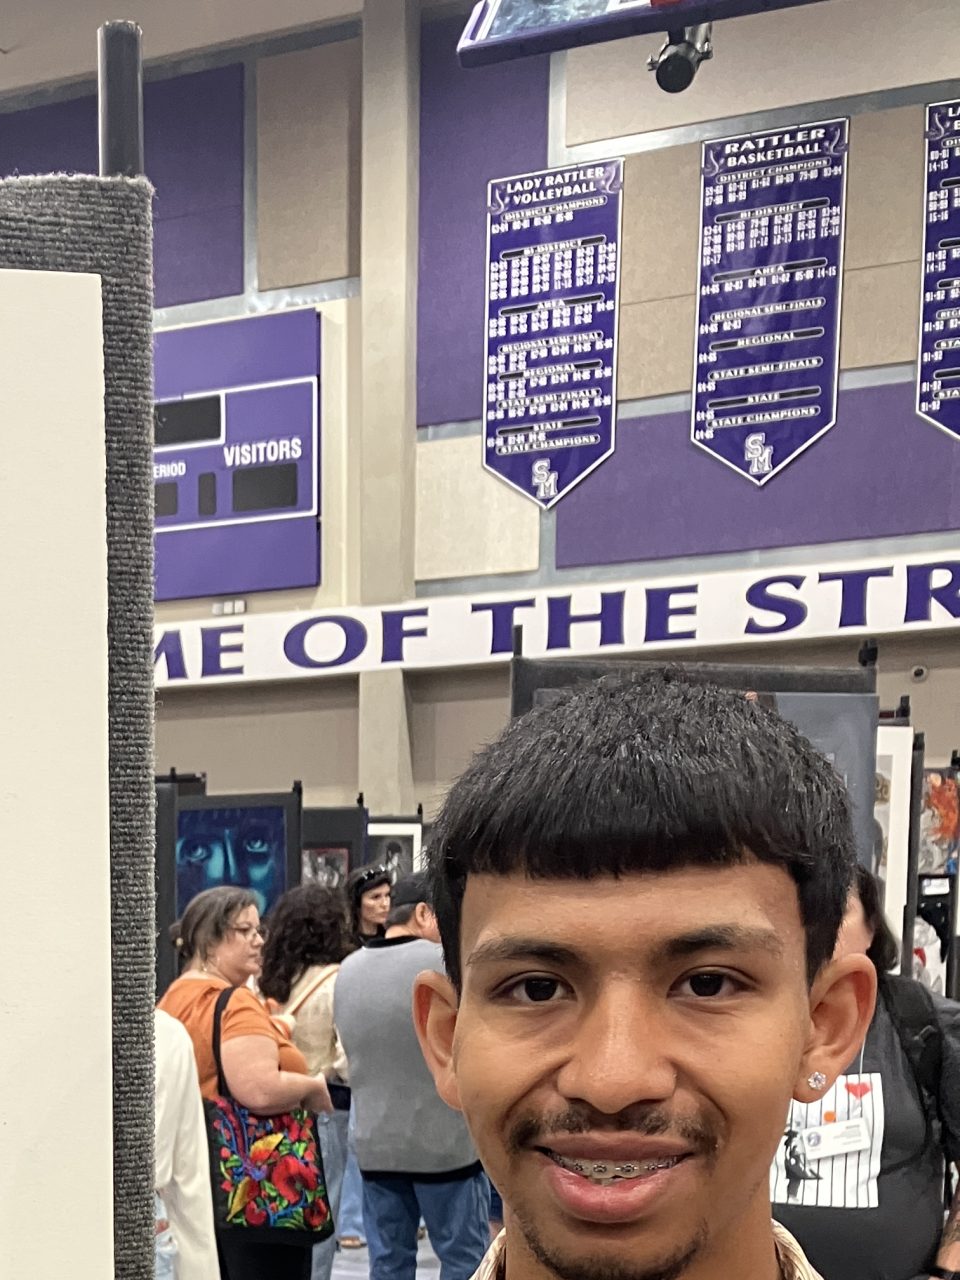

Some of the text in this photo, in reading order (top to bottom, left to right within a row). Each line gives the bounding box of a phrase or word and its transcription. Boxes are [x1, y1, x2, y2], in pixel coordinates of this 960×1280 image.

[725, 129, 826, 154] RATTLER
[726, 143, 822, 167] BASKETBALL
[720, 160, 828, 182] DISTRICT CHAMPIONS
[506, 166, 604, 194] LADY RATTLER
[513, 181, 596, 205] VOLLEYBALL
[505, 197, 604, 220] DISTRICT CHAMPIONS
[740, 203, 803, 219] BI-DISTRICT
[797, 229, 816, 241] 14-15
[754, 265, 785, 276] AREA
[817, 266, 836, 278] 14-15
[715, 308, 761, 320] REGIONAL
[737, 332, 795, 346] REGIONAL
[523, 363, 575, 377] REGIONAL
[713, 370, 746, 379] STATE
[747, 393, 780, 403] STATE
[712, 407, 816, 428] STATE CHAMPIONS
[533, 422, 562, 431] STATE
[223, 437, 302, 467] VISITORS
[502, 444, 528, 453] STATE
[533, 435, 596, 449] CHAMPIONS
[283, 607, 429, 669] OF
[471, 583, 699, 655] THE
[743, 560, 960, 634] STR
